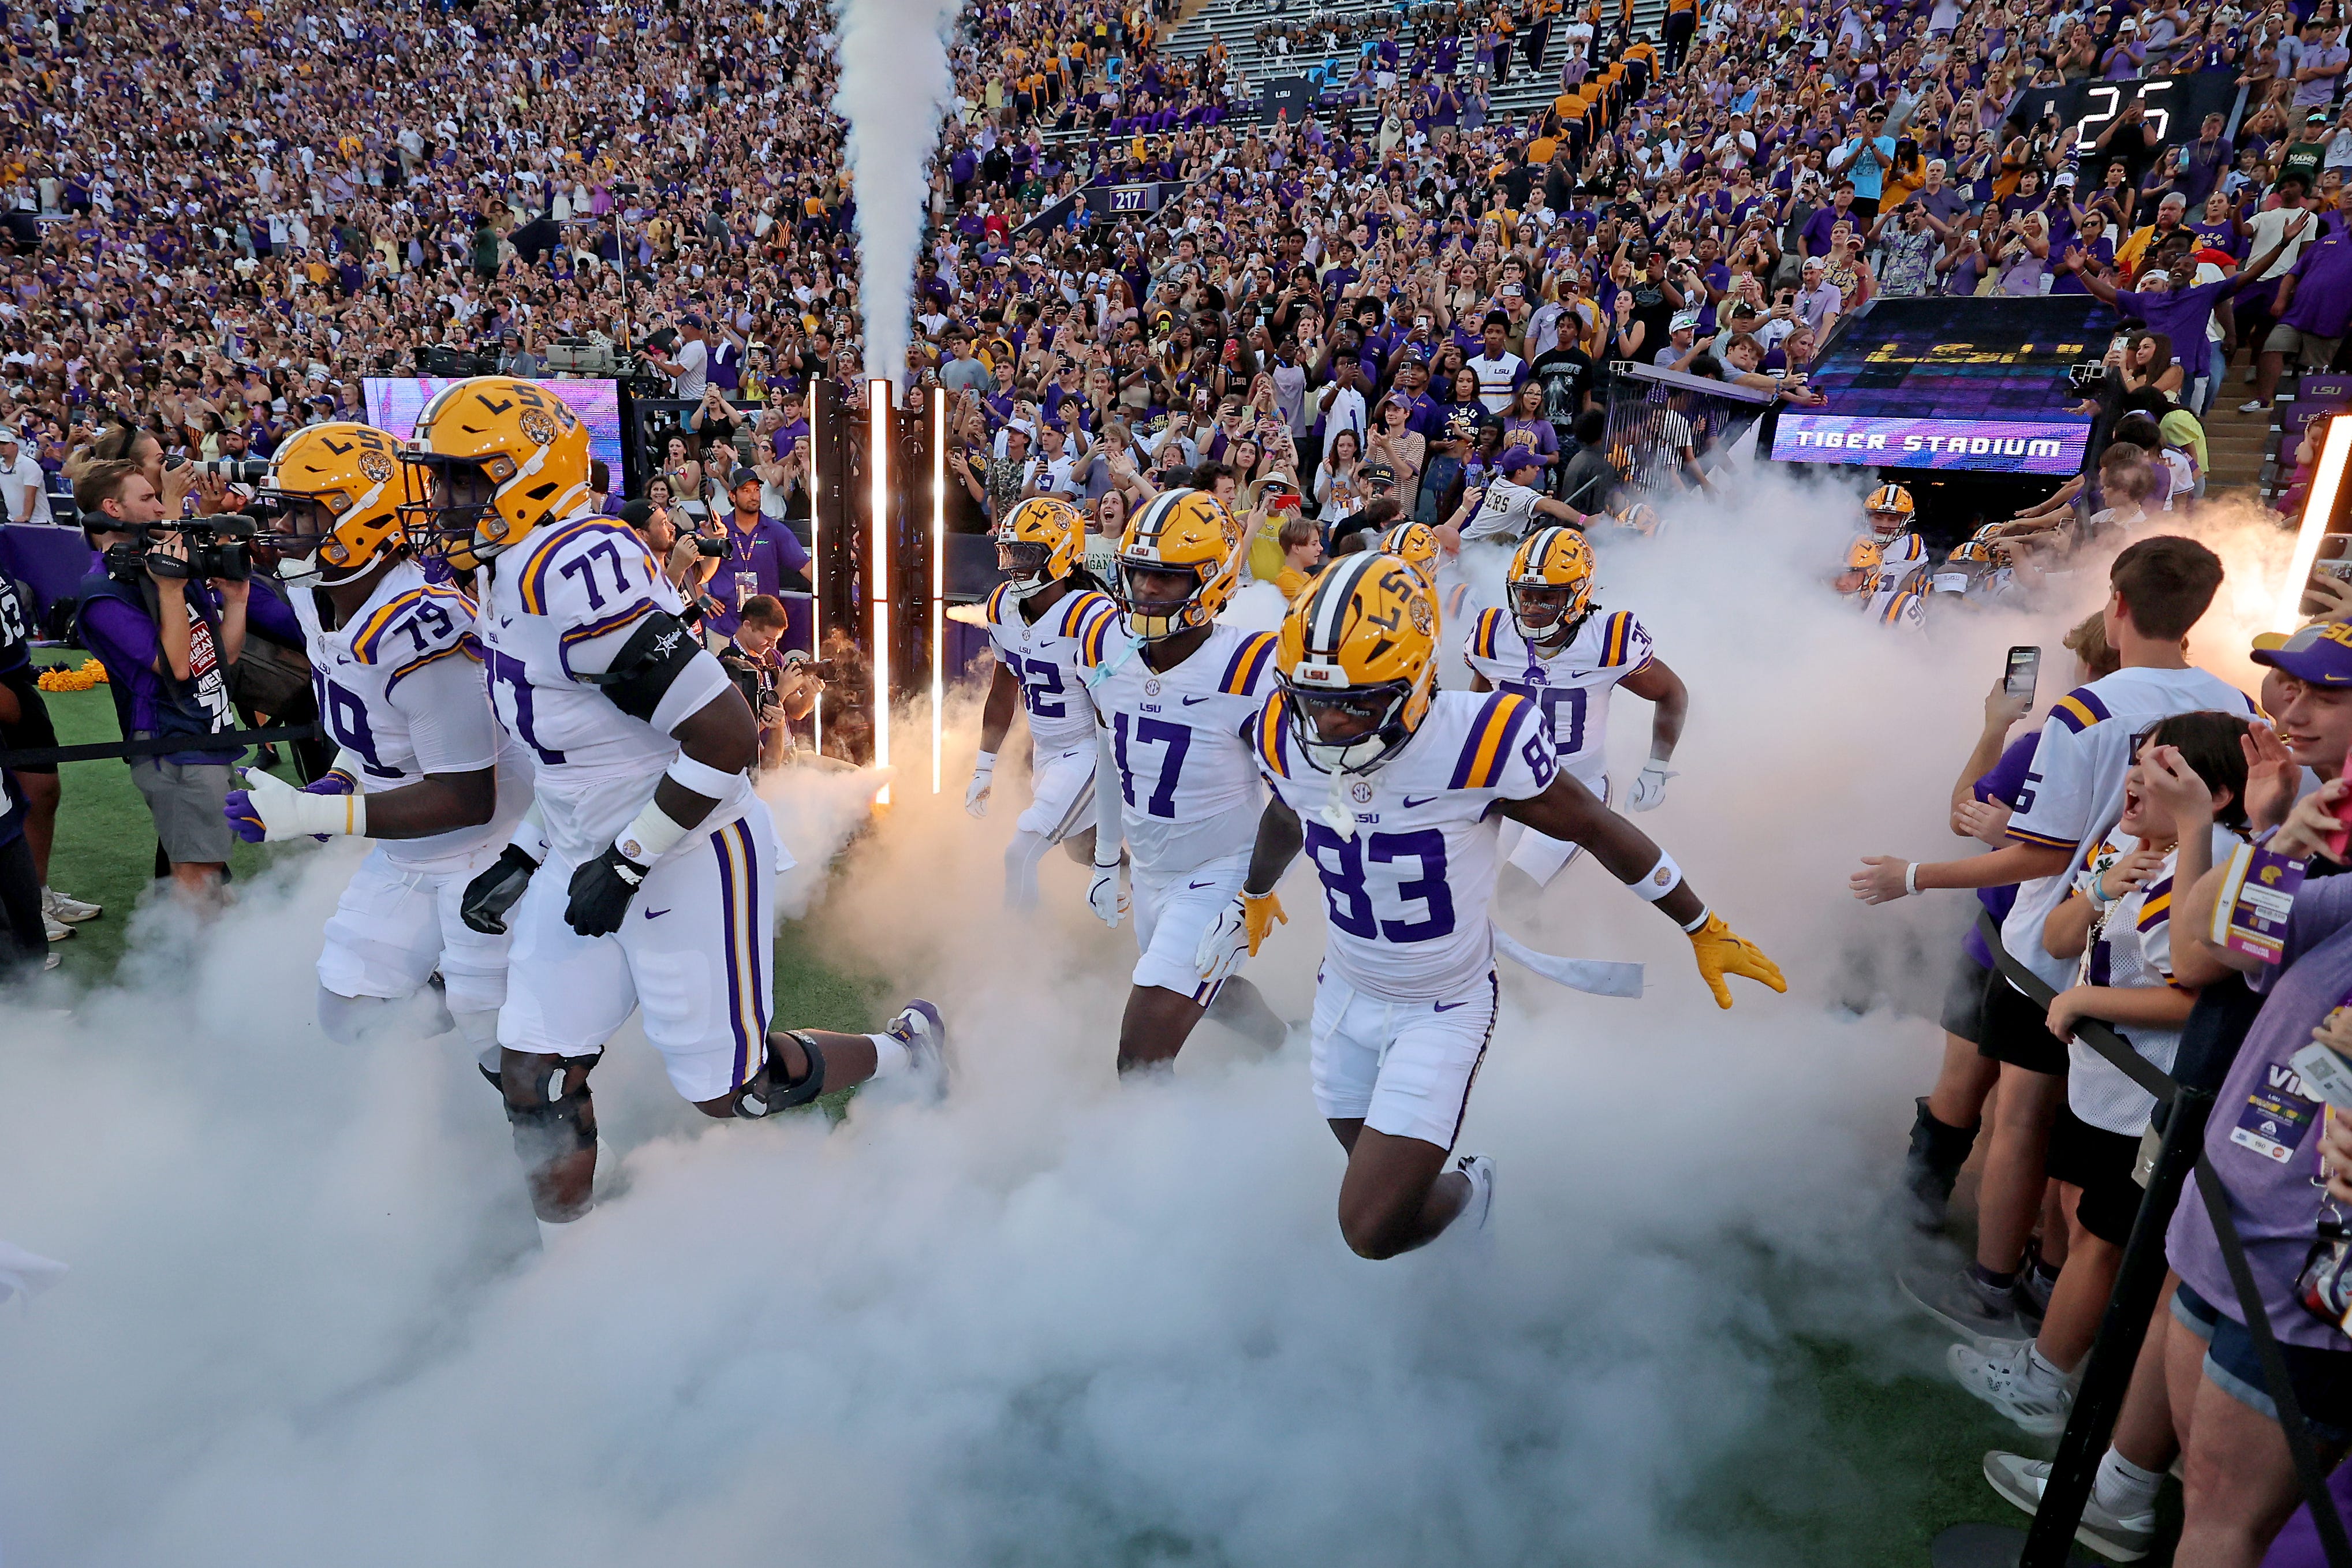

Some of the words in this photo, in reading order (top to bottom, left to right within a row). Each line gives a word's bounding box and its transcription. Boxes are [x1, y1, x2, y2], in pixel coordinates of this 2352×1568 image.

[1444, 41, 1450, 50] 7
[1275, 90, 1290, 98] LSU
[1116, 191, 1141, 209] 217
[2312, 386, 2342, 395] LSU
[2298, 413, 2318, 423] LS
[1797, 430, 1887, 450] TIGER
[1903, 435, 2062, 457] STADIUM
[1131, 546, 1150, 556] LSU
[559, 538, 631, 611] 77
[393, 600, 454, 652] 79
[1019, 645, 1031, 655] LSU
[1304, 669, 1329, 681] LSU
[1146, 680, 1160, 696] SEC
[1140, 703, 1161, 713] LSU
[1114, 711, 1192, 819] 17
[1352, 783, 1372, 803] SEC
[1354, 813, 1380, 824] SU
[1305, 819, 1456, 943] 83
